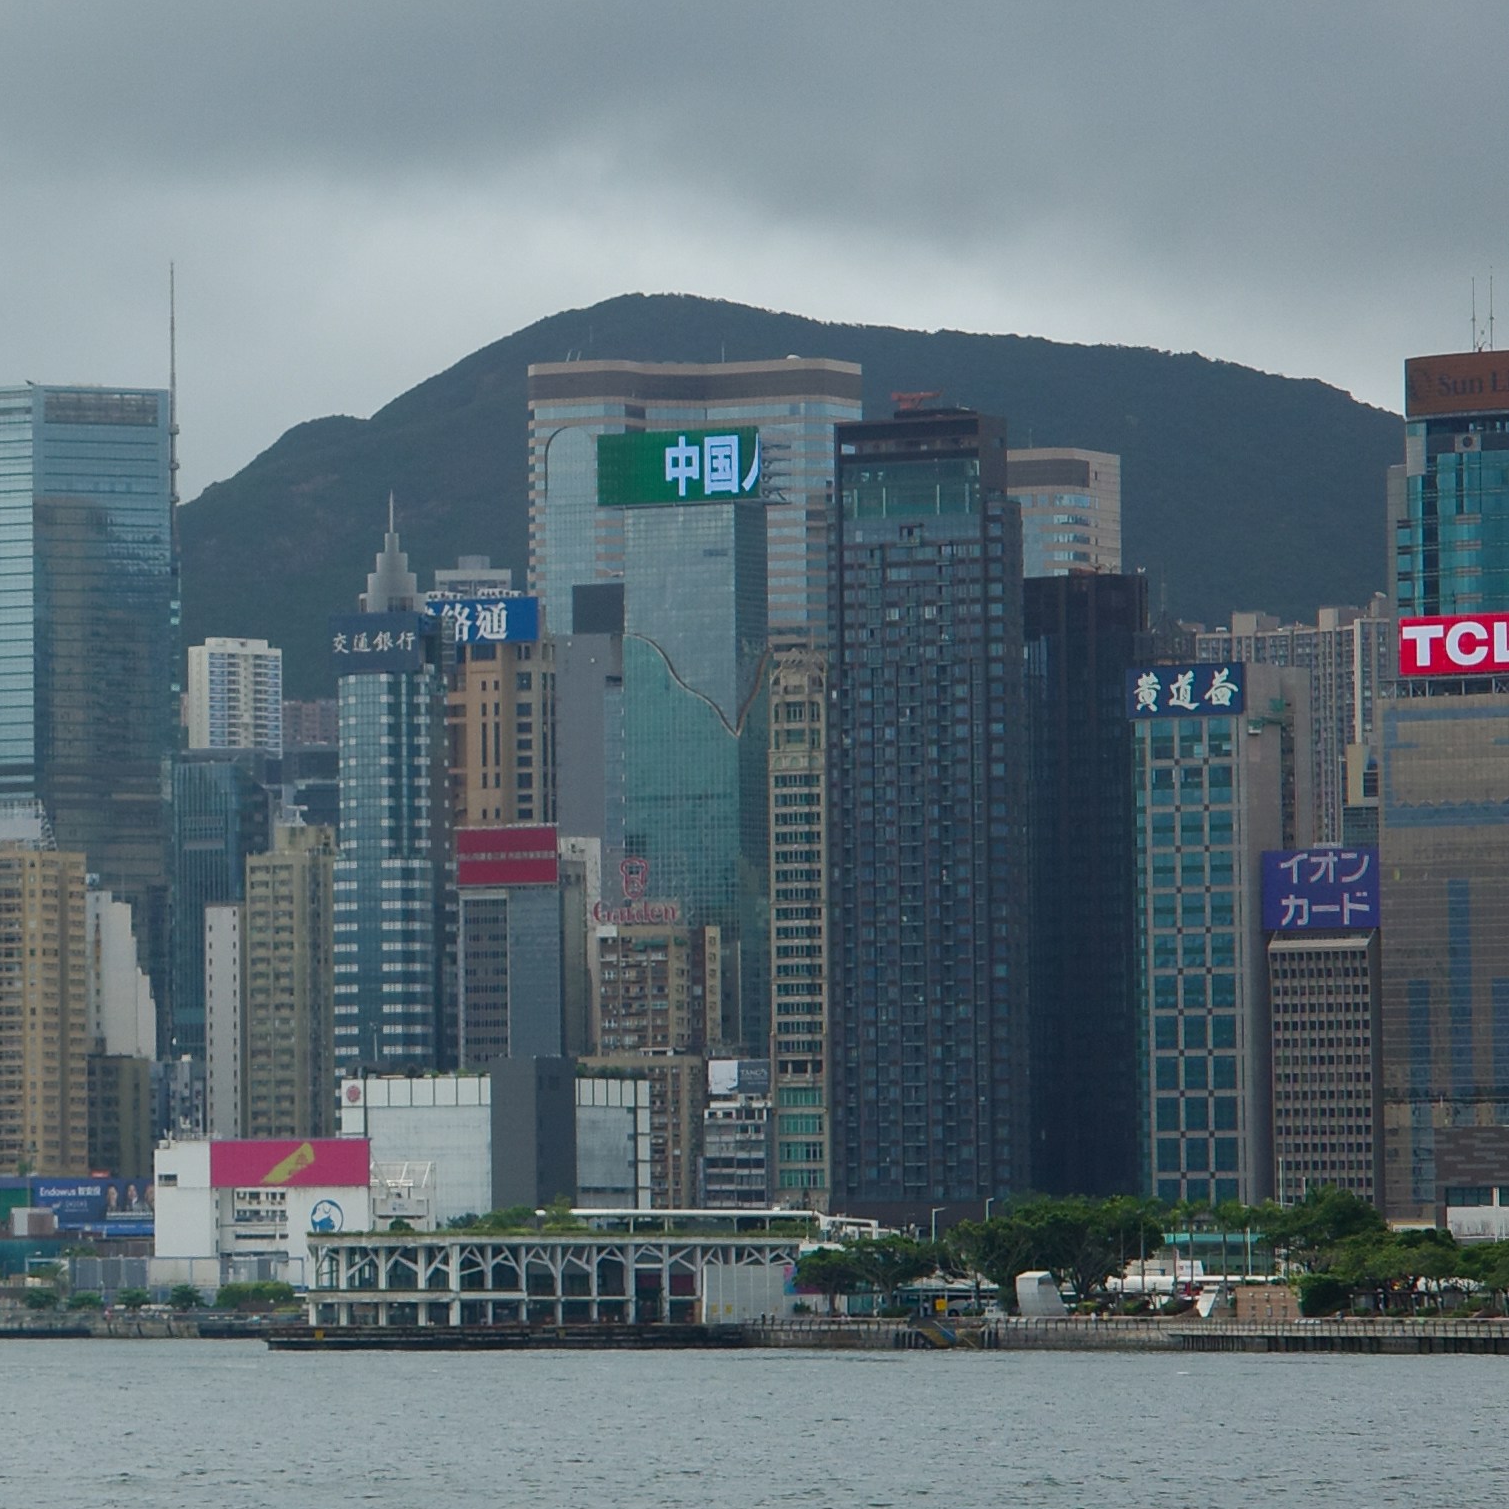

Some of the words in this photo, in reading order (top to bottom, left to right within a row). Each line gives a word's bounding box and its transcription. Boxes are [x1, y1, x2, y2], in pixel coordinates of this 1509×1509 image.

[1438, 373, 1484, 396] Sun
[331, 631, 416, 654] 交通銀行
[1280, 851, 1370, 884] イオン
[593, 900, 678, 925] Garden
[1280, 892, 1370, 926] カード
[39, 1186, 76, 1197] Endowus
